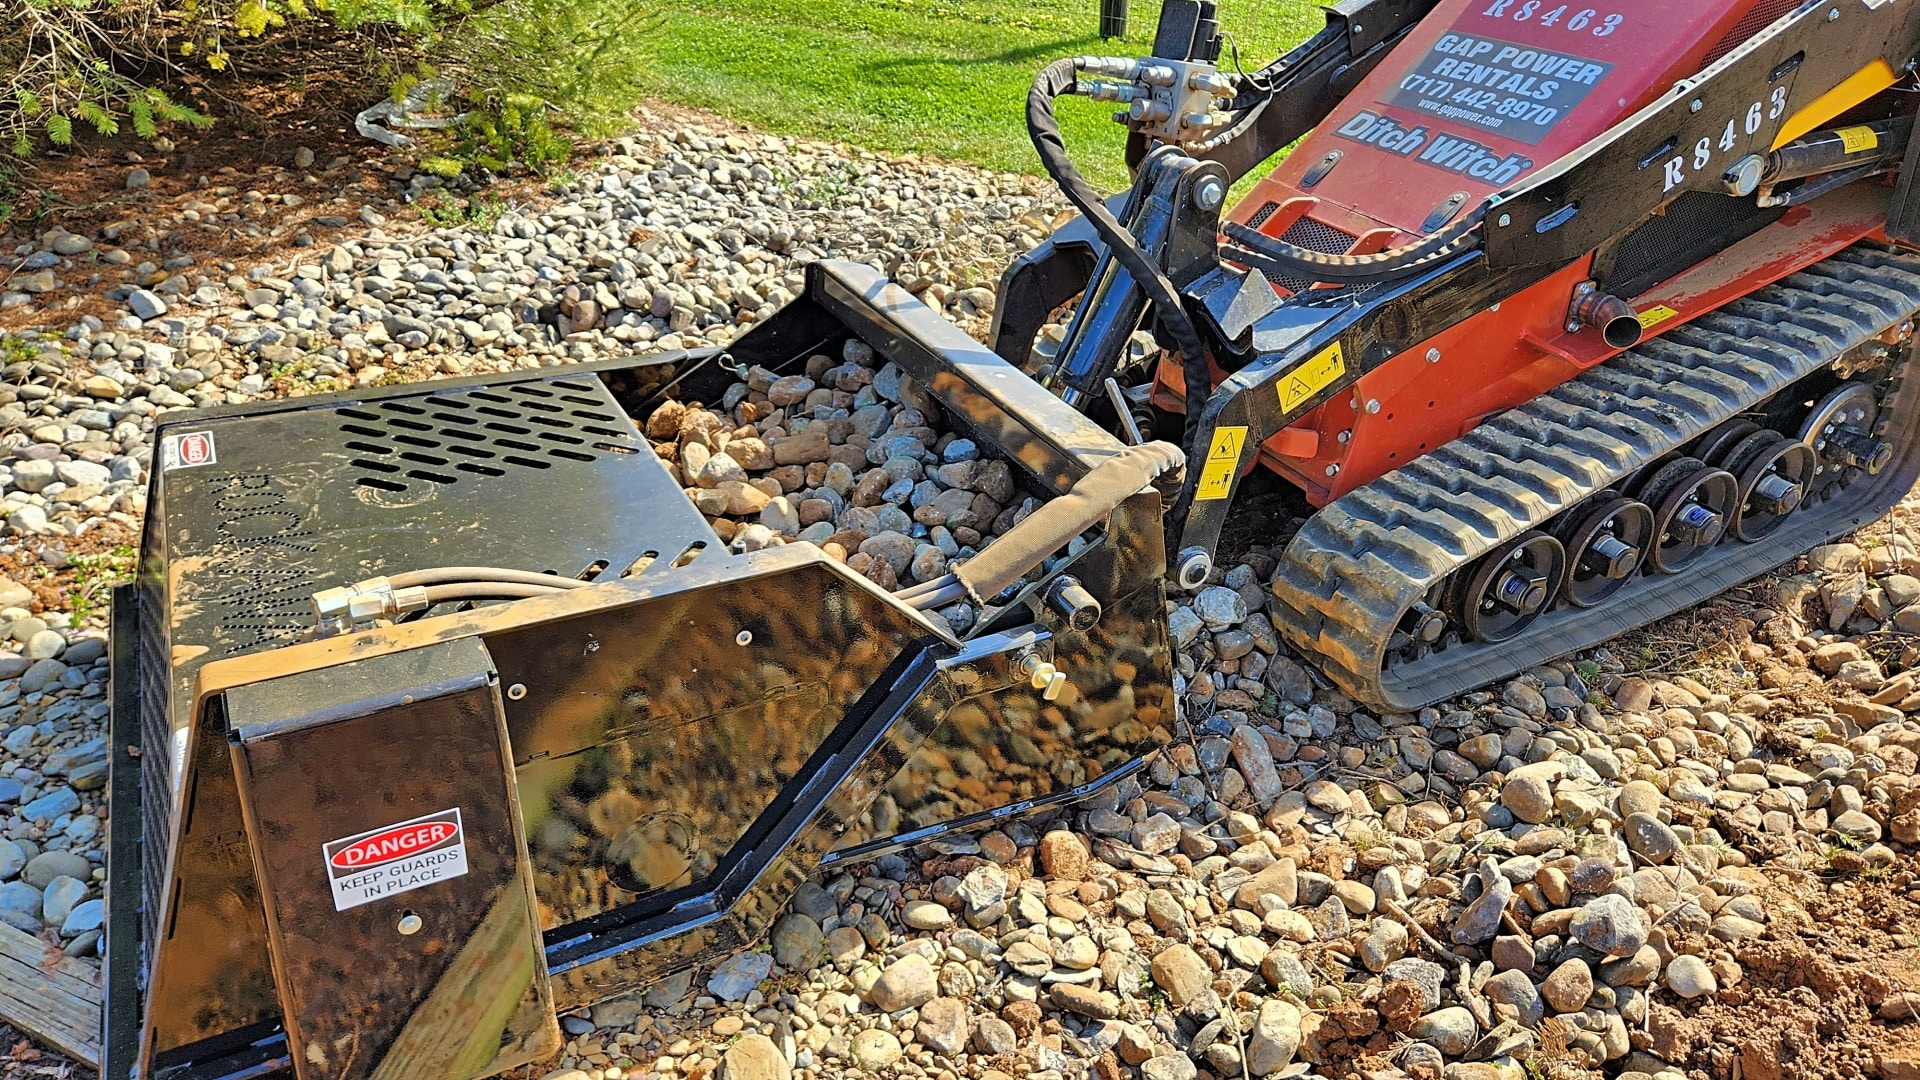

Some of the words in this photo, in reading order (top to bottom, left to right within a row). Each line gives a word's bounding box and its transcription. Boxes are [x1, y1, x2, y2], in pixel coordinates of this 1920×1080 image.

[1483, 0, 1623, 37] R8463
[1432, 58, 1558, 100] RENTALS
[1435, 35, 1494, 58] GAP
[1492, 46, 1603, 85] POWER
[1400, 74, 1452, 97] (717)
[1452, 87, 1557, 125] 442-8970
[1418, 98, 1503, 127] www.gappower.com
[1339, 113, 1425, 153] Ditch
[1421, 133, 1524, 185] Witch
[1663, 86, 1785, 192] R8463
[345, 825, 446, 865] DANGER
[340, 872, 383, 891] KEEP
[390, 850, 458, 877] GUARDS
[364, 886, 381, 898] IN
[387, 867, 442, 891] PLACE
